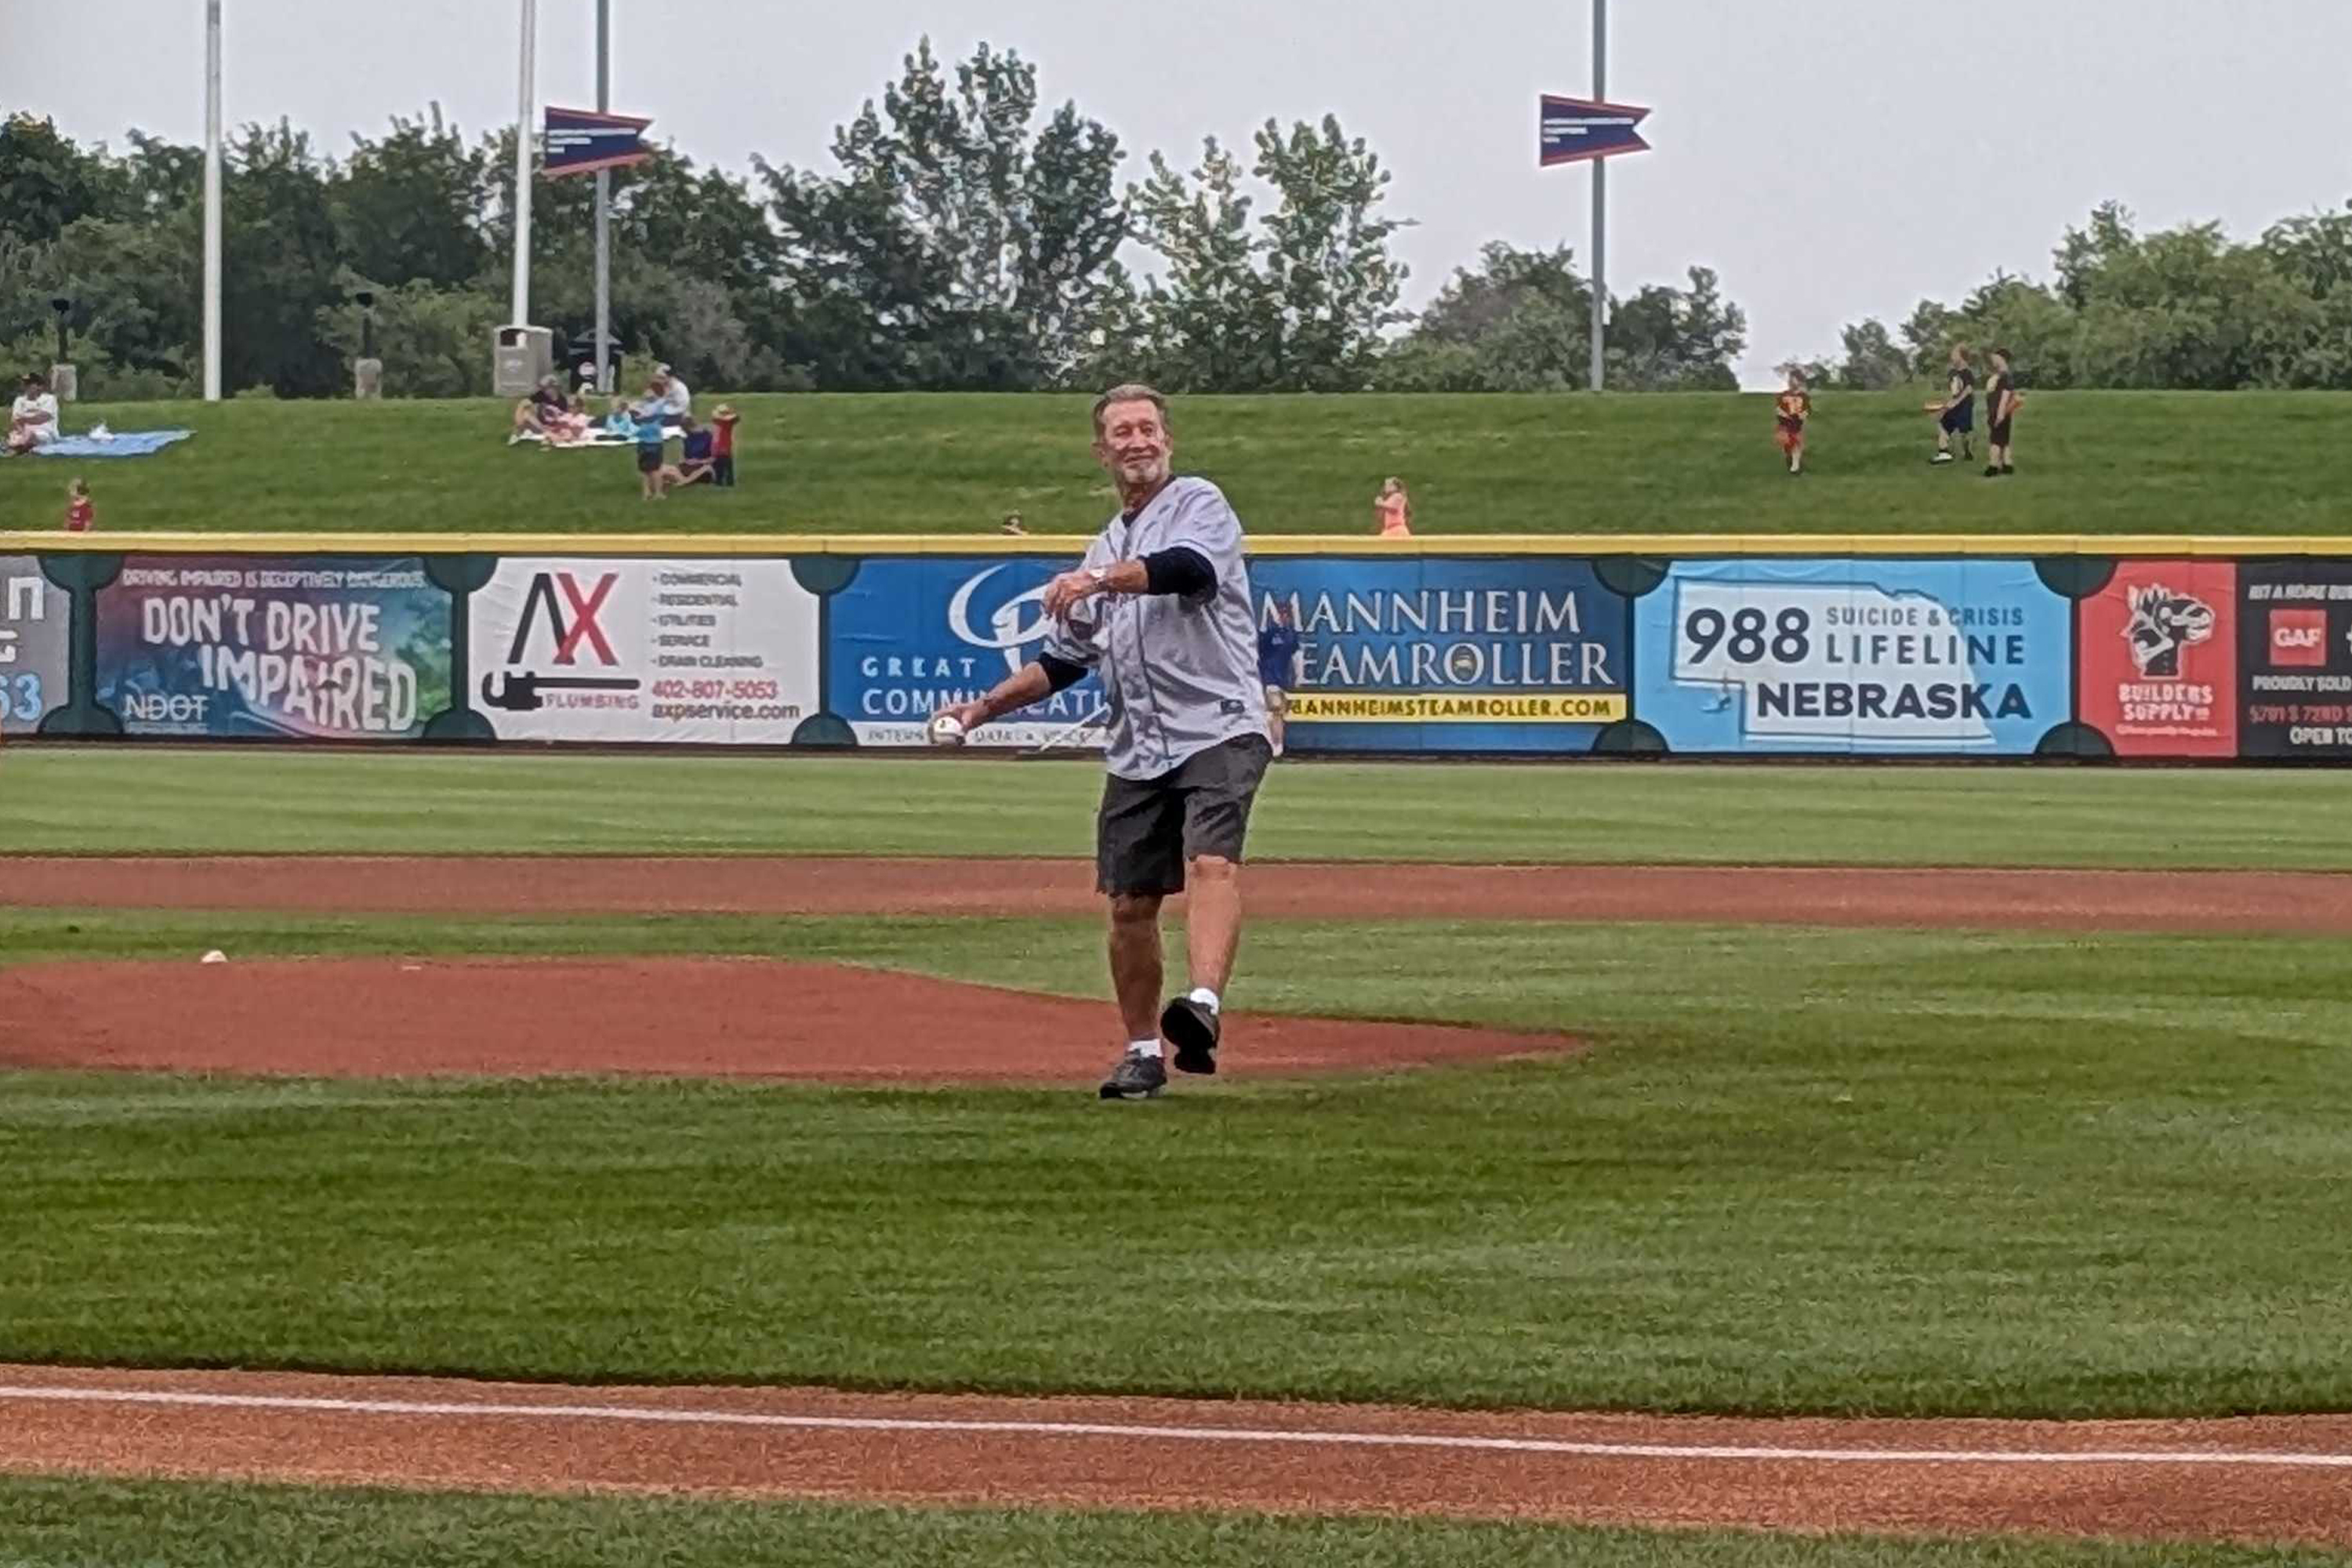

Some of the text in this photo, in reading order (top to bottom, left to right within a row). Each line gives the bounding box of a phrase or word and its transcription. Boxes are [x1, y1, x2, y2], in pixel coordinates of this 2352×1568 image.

[1259, 590, 1581, 633] MANNHEIM
[1826, 607, 2024, 626] SUICIDE & CRISIS
[143, 593, 380, 655] DON'T DRIVE
[1685, 608, 1809, 664] 988
[2274, 627, 2321, 648] GAF
[1826, 635, 2024, 665] LIFELINE
[862, 657, 976, 677] GREAT
[1294, 641, 1615, 685] EAMROLLER
[199, 644, 417, 731] IMPAIRED
[2119, 684, 2213, 704] BUILDERS
[2252, 676, 2315, 691] PROUDLY
[125, 693, 209, 720] NDOT
[546, 694, 640, 710] PLUMBING
[652, 701, 800, 722] axpservice.com
[1757, 683, 2032, 719] NEBRASKA
[2123, 703, 2194, 720] SUPPLY
[2289, 726, 2333, 744] OPEN
